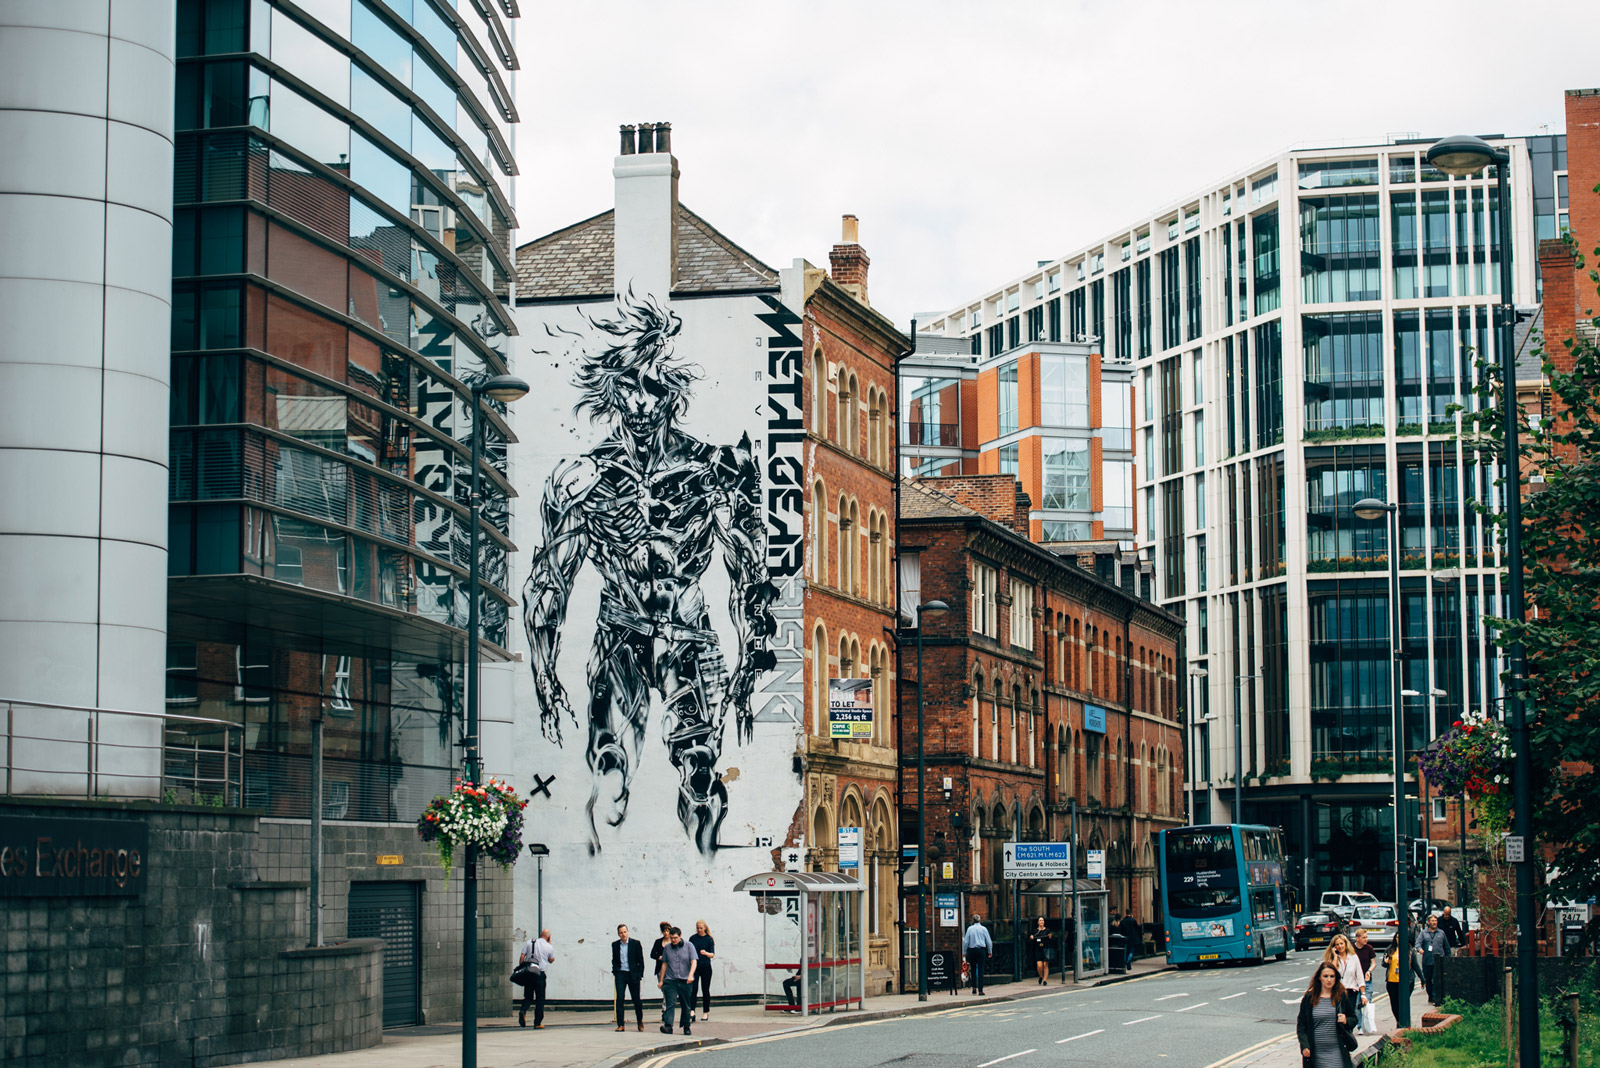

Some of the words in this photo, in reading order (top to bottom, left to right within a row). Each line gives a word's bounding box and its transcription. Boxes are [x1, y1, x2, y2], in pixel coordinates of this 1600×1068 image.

[1194, 836, 1212, 844] MAX
[0, 846, 28, 877] es
[36, 838, 140, 888] Exchange
